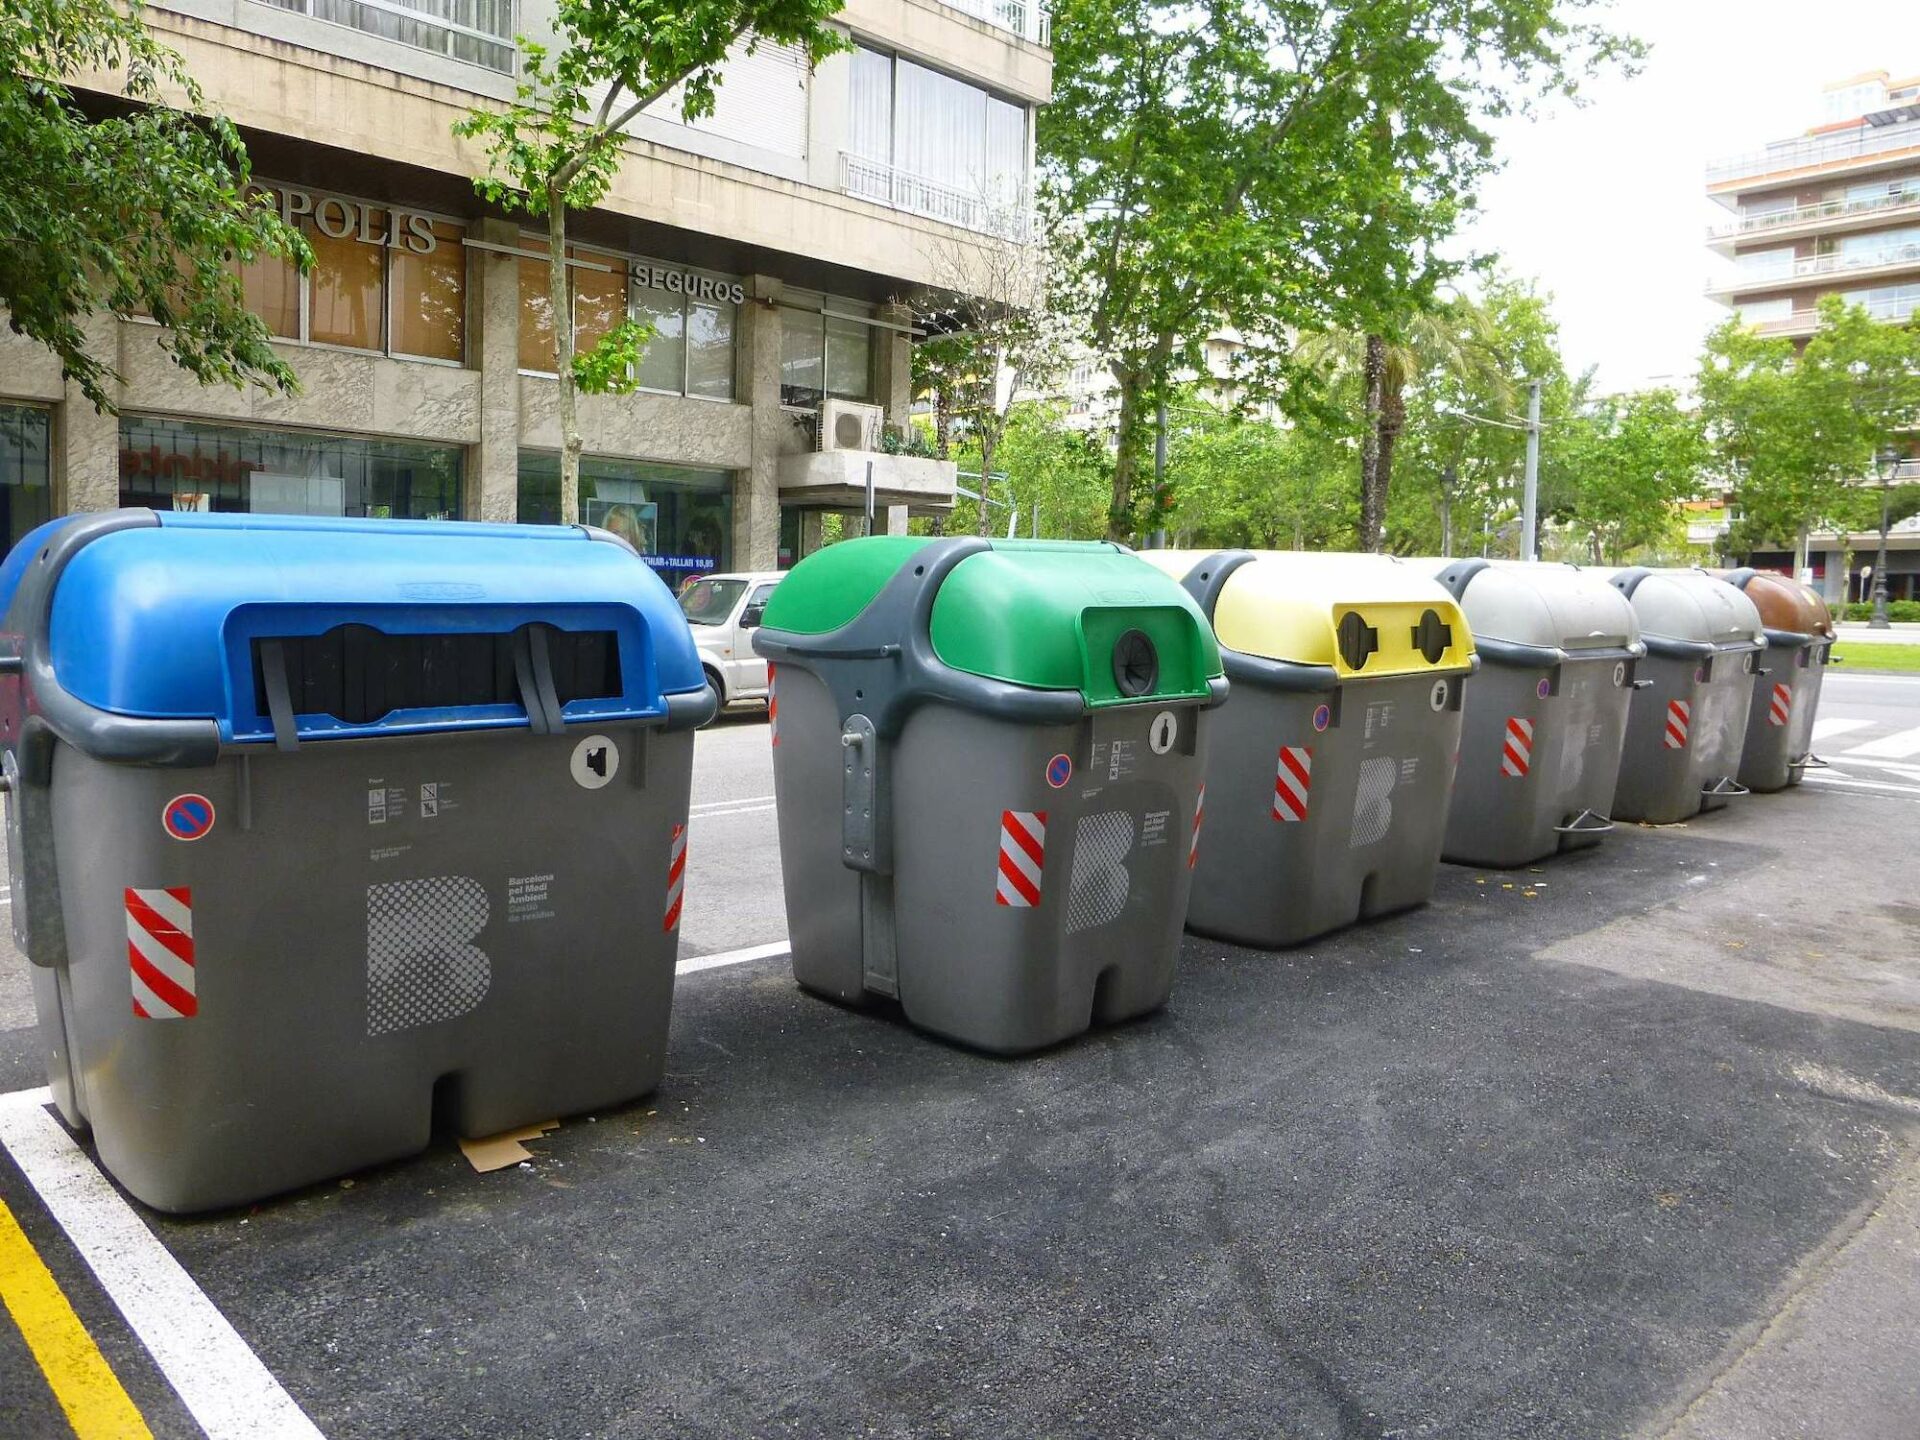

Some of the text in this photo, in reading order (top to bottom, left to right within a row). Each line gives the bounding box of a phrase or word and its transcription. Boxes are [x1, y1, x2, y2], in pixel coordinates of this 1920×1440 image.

[635, 264, 744, 305] SEGUROS
[508, 874, 554, 886] Barcelona
[1065, 811, 1134, 935] B
[508, 892, 548, 905] Ambient
[525, 882, 547, 893] Medi
[367, 876, 491, 1036] B
